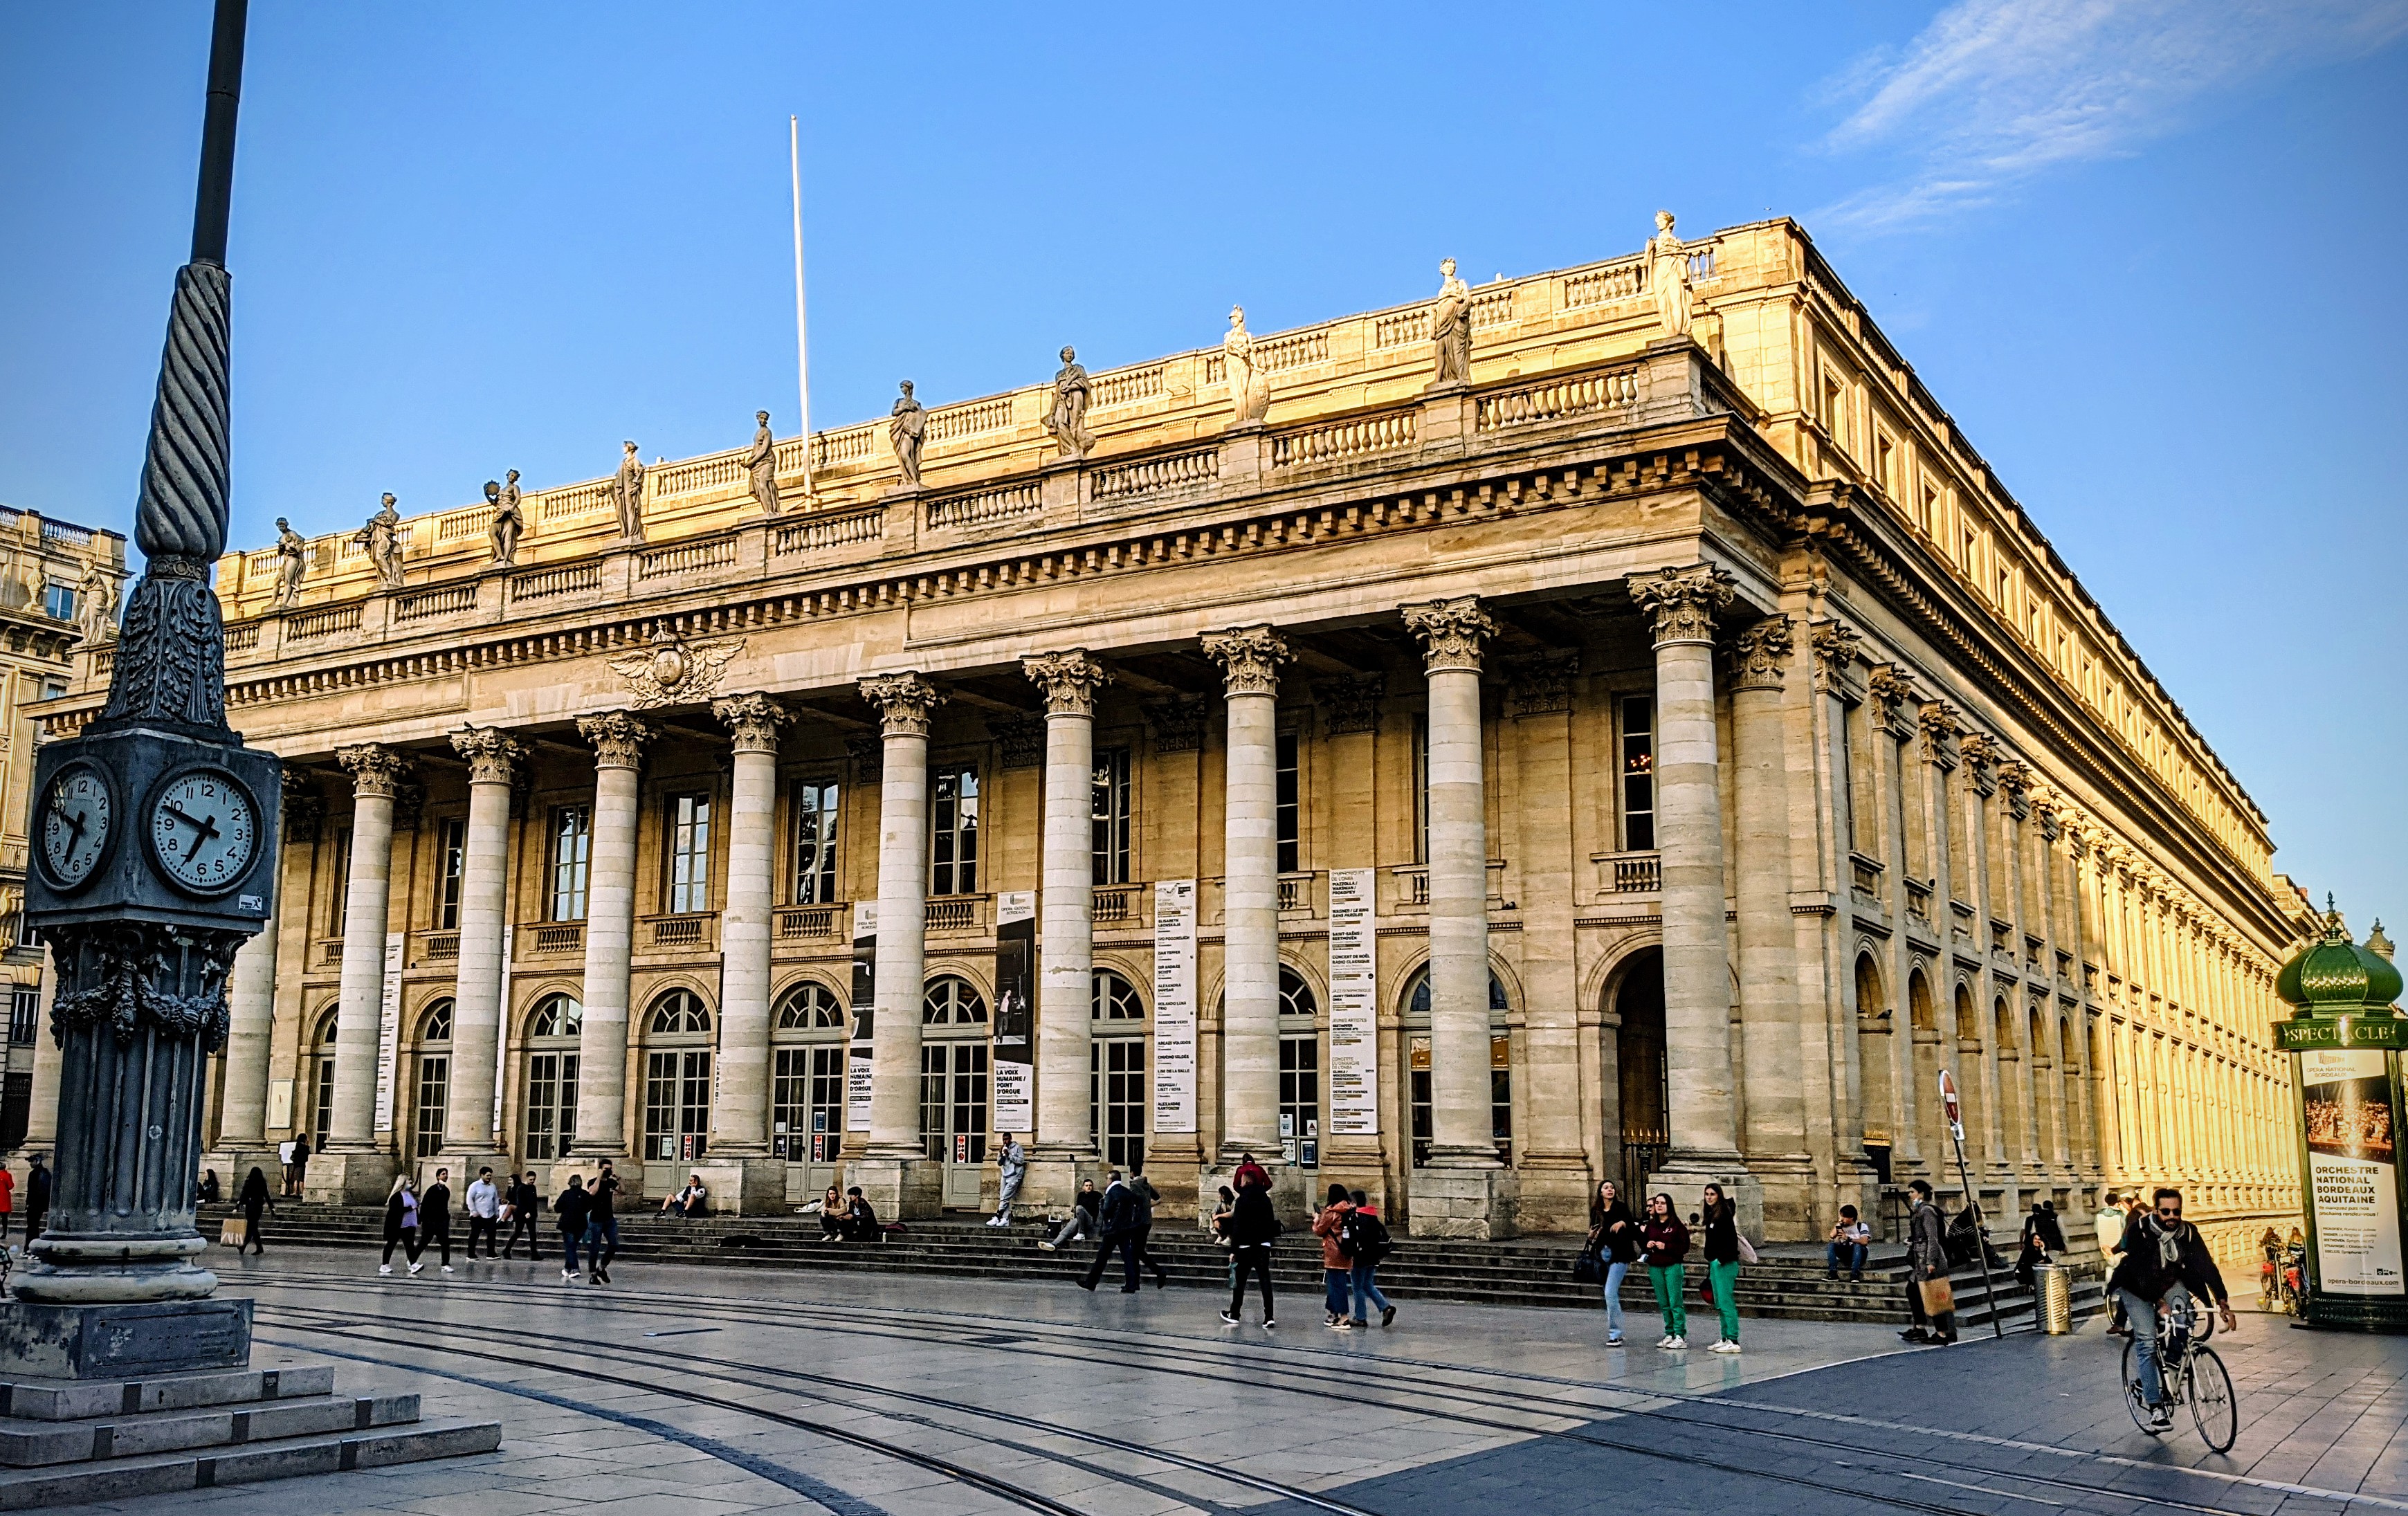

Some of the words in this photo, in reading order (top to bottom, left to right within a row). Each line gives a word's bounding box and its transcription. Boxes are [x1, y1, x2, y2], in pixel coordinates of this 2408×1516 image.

[78, 780, 88, 793] 12
[201, 783, 214, 797] 12
[186, 786, 193, 800] 11
[222, 792, 226, 805] 1
[99, 797, 107, 810] 2
[171, 799, 183, 813] 10
[231, 809, 241, 821] 2
[52, 823, 60, 835] 9
[100, 817, 107, 830] 3
[164, 818, 174, 831] 9
[234, 829, 243, 841] 3
[54, 842, 61, 854] 8
[94, 837, 102, 849] 4
[168, 839, 178, 851] 8
[85, 853, 92, 865] 5
[227, 847, 237, 859] 4
[72, 860, 80, 872] 6
[197, 863, 207, 875] 6
[215, 859, 224, 872] 5
